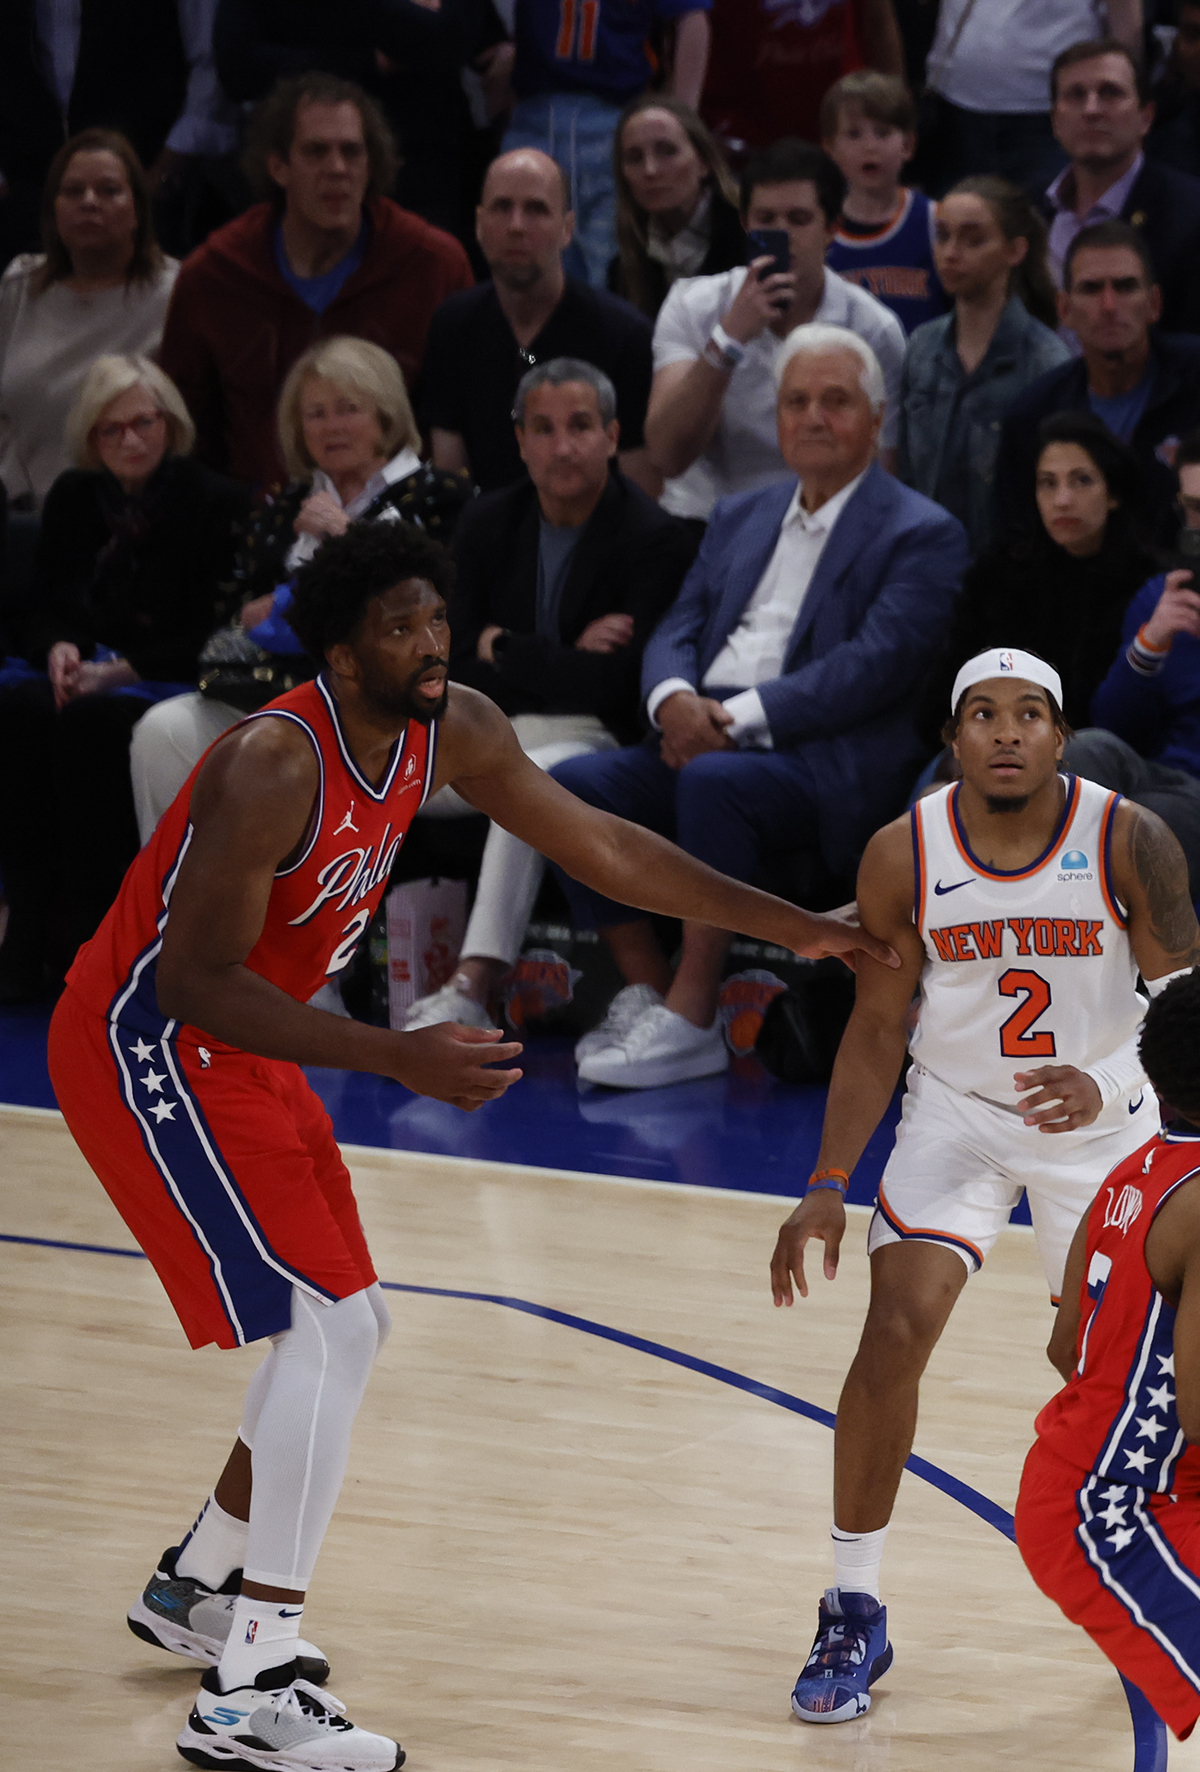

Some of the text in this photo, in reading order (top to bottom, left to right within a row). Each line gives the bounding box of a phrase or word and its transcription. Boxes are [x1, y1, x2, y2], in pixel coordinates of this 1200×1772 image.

[1057, 872, 1093, 882] sphere
[929, 917, 1104, 962] NEW YORK
[998, 968, 1057, 1058] 2
